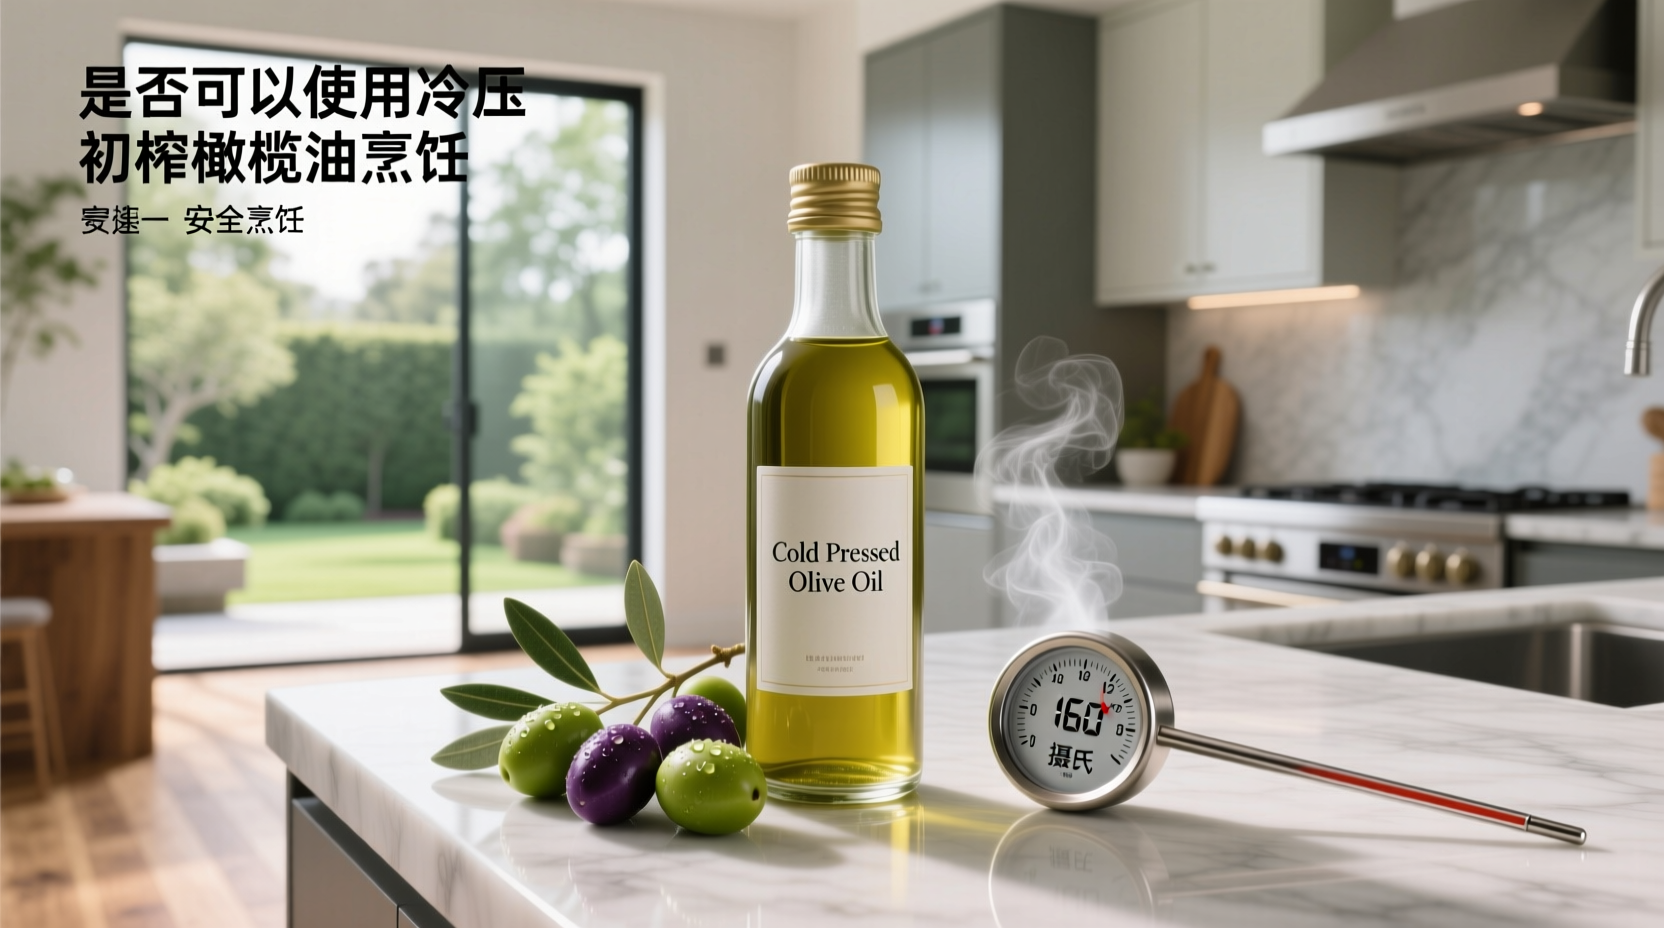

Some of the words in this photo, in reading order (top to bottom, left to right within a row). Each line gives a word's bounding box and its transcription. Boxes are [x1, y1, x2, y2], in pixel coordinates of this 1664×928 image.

[772, 541, 820, 563] Cold
[826, 540, 900, 563] Pressed
[788, 570, 846, 593] Olive
[851, 569, 883, 593] Oil
[1054, 696, 1104, 737] 160
[1047, 741, 1094, 775] 摄氏
